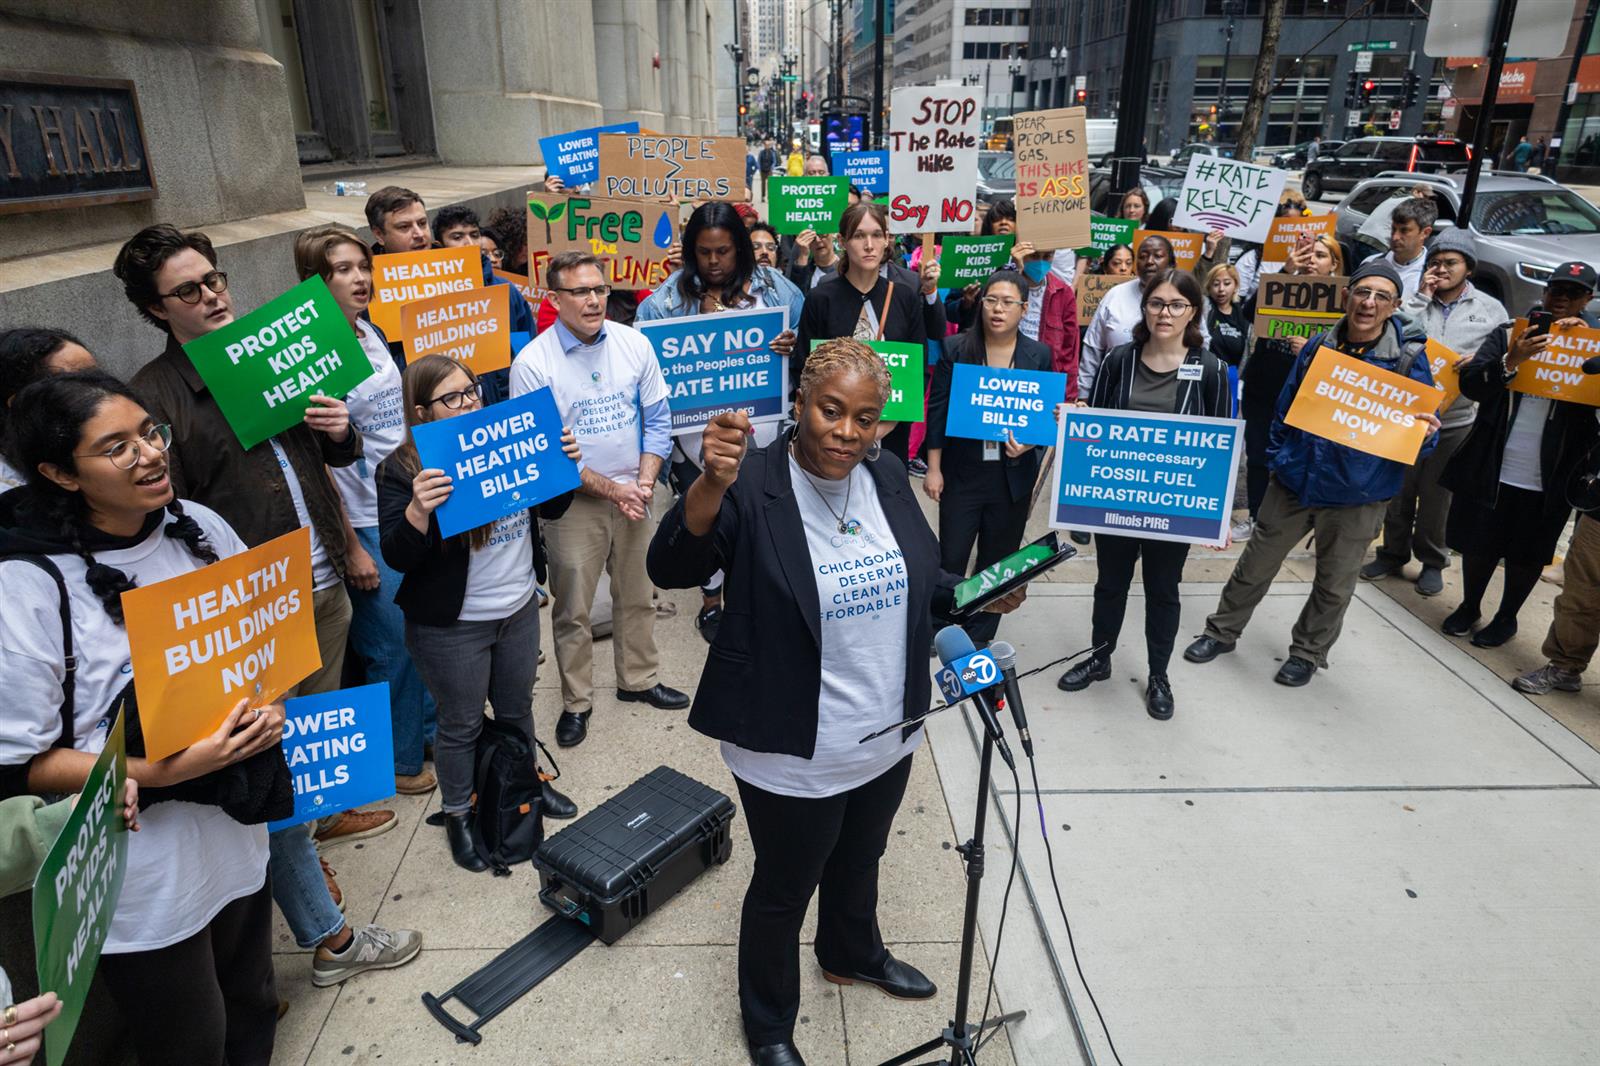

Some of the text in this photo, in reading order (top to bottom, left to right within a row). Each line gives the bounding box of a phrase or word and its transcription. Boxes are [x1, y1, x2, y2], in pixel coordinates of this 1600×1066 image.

[912, 96, 976, 125] STOP
[1015, 116, 1046, 131] DEAR
[31, 105, 141, 176] HALL
[558, 137, 593, 152] LOWER
[627, 136, 716, 161] PEOPLE
[890, 128, 976, 152] The Rate
[1018, 130, 1075, 147] PEOPLES
[558, 149, 598, 165] HEATING
[847, 157, 881, 166] LOWER
[1019, 149, 1048, 161] GAS,
[569, 162, 594, 175] BILLS
[844, 167, 884, 176] HEATING
[851, 176, 877, 185] BILLS
[1020, 160, 1085, 177] THIS HIKE
[1196, 160, 1272, 189] #RATE
[606, 177, 731, 199] POLLUTERS
[781, 184, 837, 195] PROTECT
[1018, 175, 1085, 198] IS ASS
[796, 197, 824, 208] KIDS
[891, 194, 974, 228] Say NO
[1186, 188, 1273, 223] RELIEF
[567, 197, 644, 243] Free
[785, 211, 832, 222] HEALTH
[1278, 221, 1328, 232] HEALTHY
[955, 243, 1004, 254] PROTECT
[1091, 242, 1114, 251] EALT
[1094, 232, 1116, 241] KIDS
[383, 258, 465, 282] HEALTHY
[532, 251, 672, 287] FLINES
[955, 267, 996, 278] HEALTH
[966, 256, 991, 266] KIDS
[379, 278, 474, 304] BUILDINGS
[1265, 281, 1346, 314] PEOPL
[416, 299, 492, 330] HEALTHY
[224, 299, 320, 366] PROTECT
[412, 318, 498, 354] BUILDINGS
[662, 327, 765, 359] SAY NO
[267, 335, 317, 376] KIDS
[437, 343, 476, 361] OW
[672, 363, 693, 375] the
[696, 356, 745, 372] Peoples
[747, 354, 771, 365] Gas
[262, 349, 343, 409] HEALTH
[668, 370, 769, 399] RATE HIKE
[979, 376, 1040, 394] LOWER
[1331, 365, 1420, 407] HEALTHY
[1535, 367, 1584, 386] NOW
[368, 386, 402, 402] CHICAGO
[971, 393, 1045, 412] HEATING
[1315, 381, 1416, 428] BUILDINGS
[373, 408, 399, 421] CLEAN
[576, 417, 608, 426] CLEAN
[582, 402, 622, 416] DESERVE
[982, 411, 1029, 428] BILLS
[458, 411, 536, 453] LOWER
[1331, 408, 1382, 436] NOW
[1068, 421, 1232, 450] NO RATE HIKE
[455, 433, 549, 480] HEATING
[1086, 445, 1207, 470] for unnecessary
[480, 463, 540, 499] BILLS
[1090, 465, 1197, 488] FOSSIL FUEL
[1065, 484, 1220, 511] INFRASTRUCTURE
[1105, 512, 1170, 530] Illinois PIRG
[819, 548, 903, 575] CHICAGOAN
[839, 563, 904, 588] DESERVE
[172, 556, 290, 631] HEALTHY
[833, 579, 905, 604] CLEAN AN
[164, 589, 300, 676] BUILDINGS
[221, 639, 276, 694] NOW
[963, 655, 996, 683] abc 7
[282, 708, 356, 739] OWER
[283, 732, 367, 767] ATING
[292, 764, 349, 795] ILLS
[55, 753, 118, 909] PROTECT
[76, 825, 108, 914] KIDS
[66, 845, 117, 986] HEALTH
